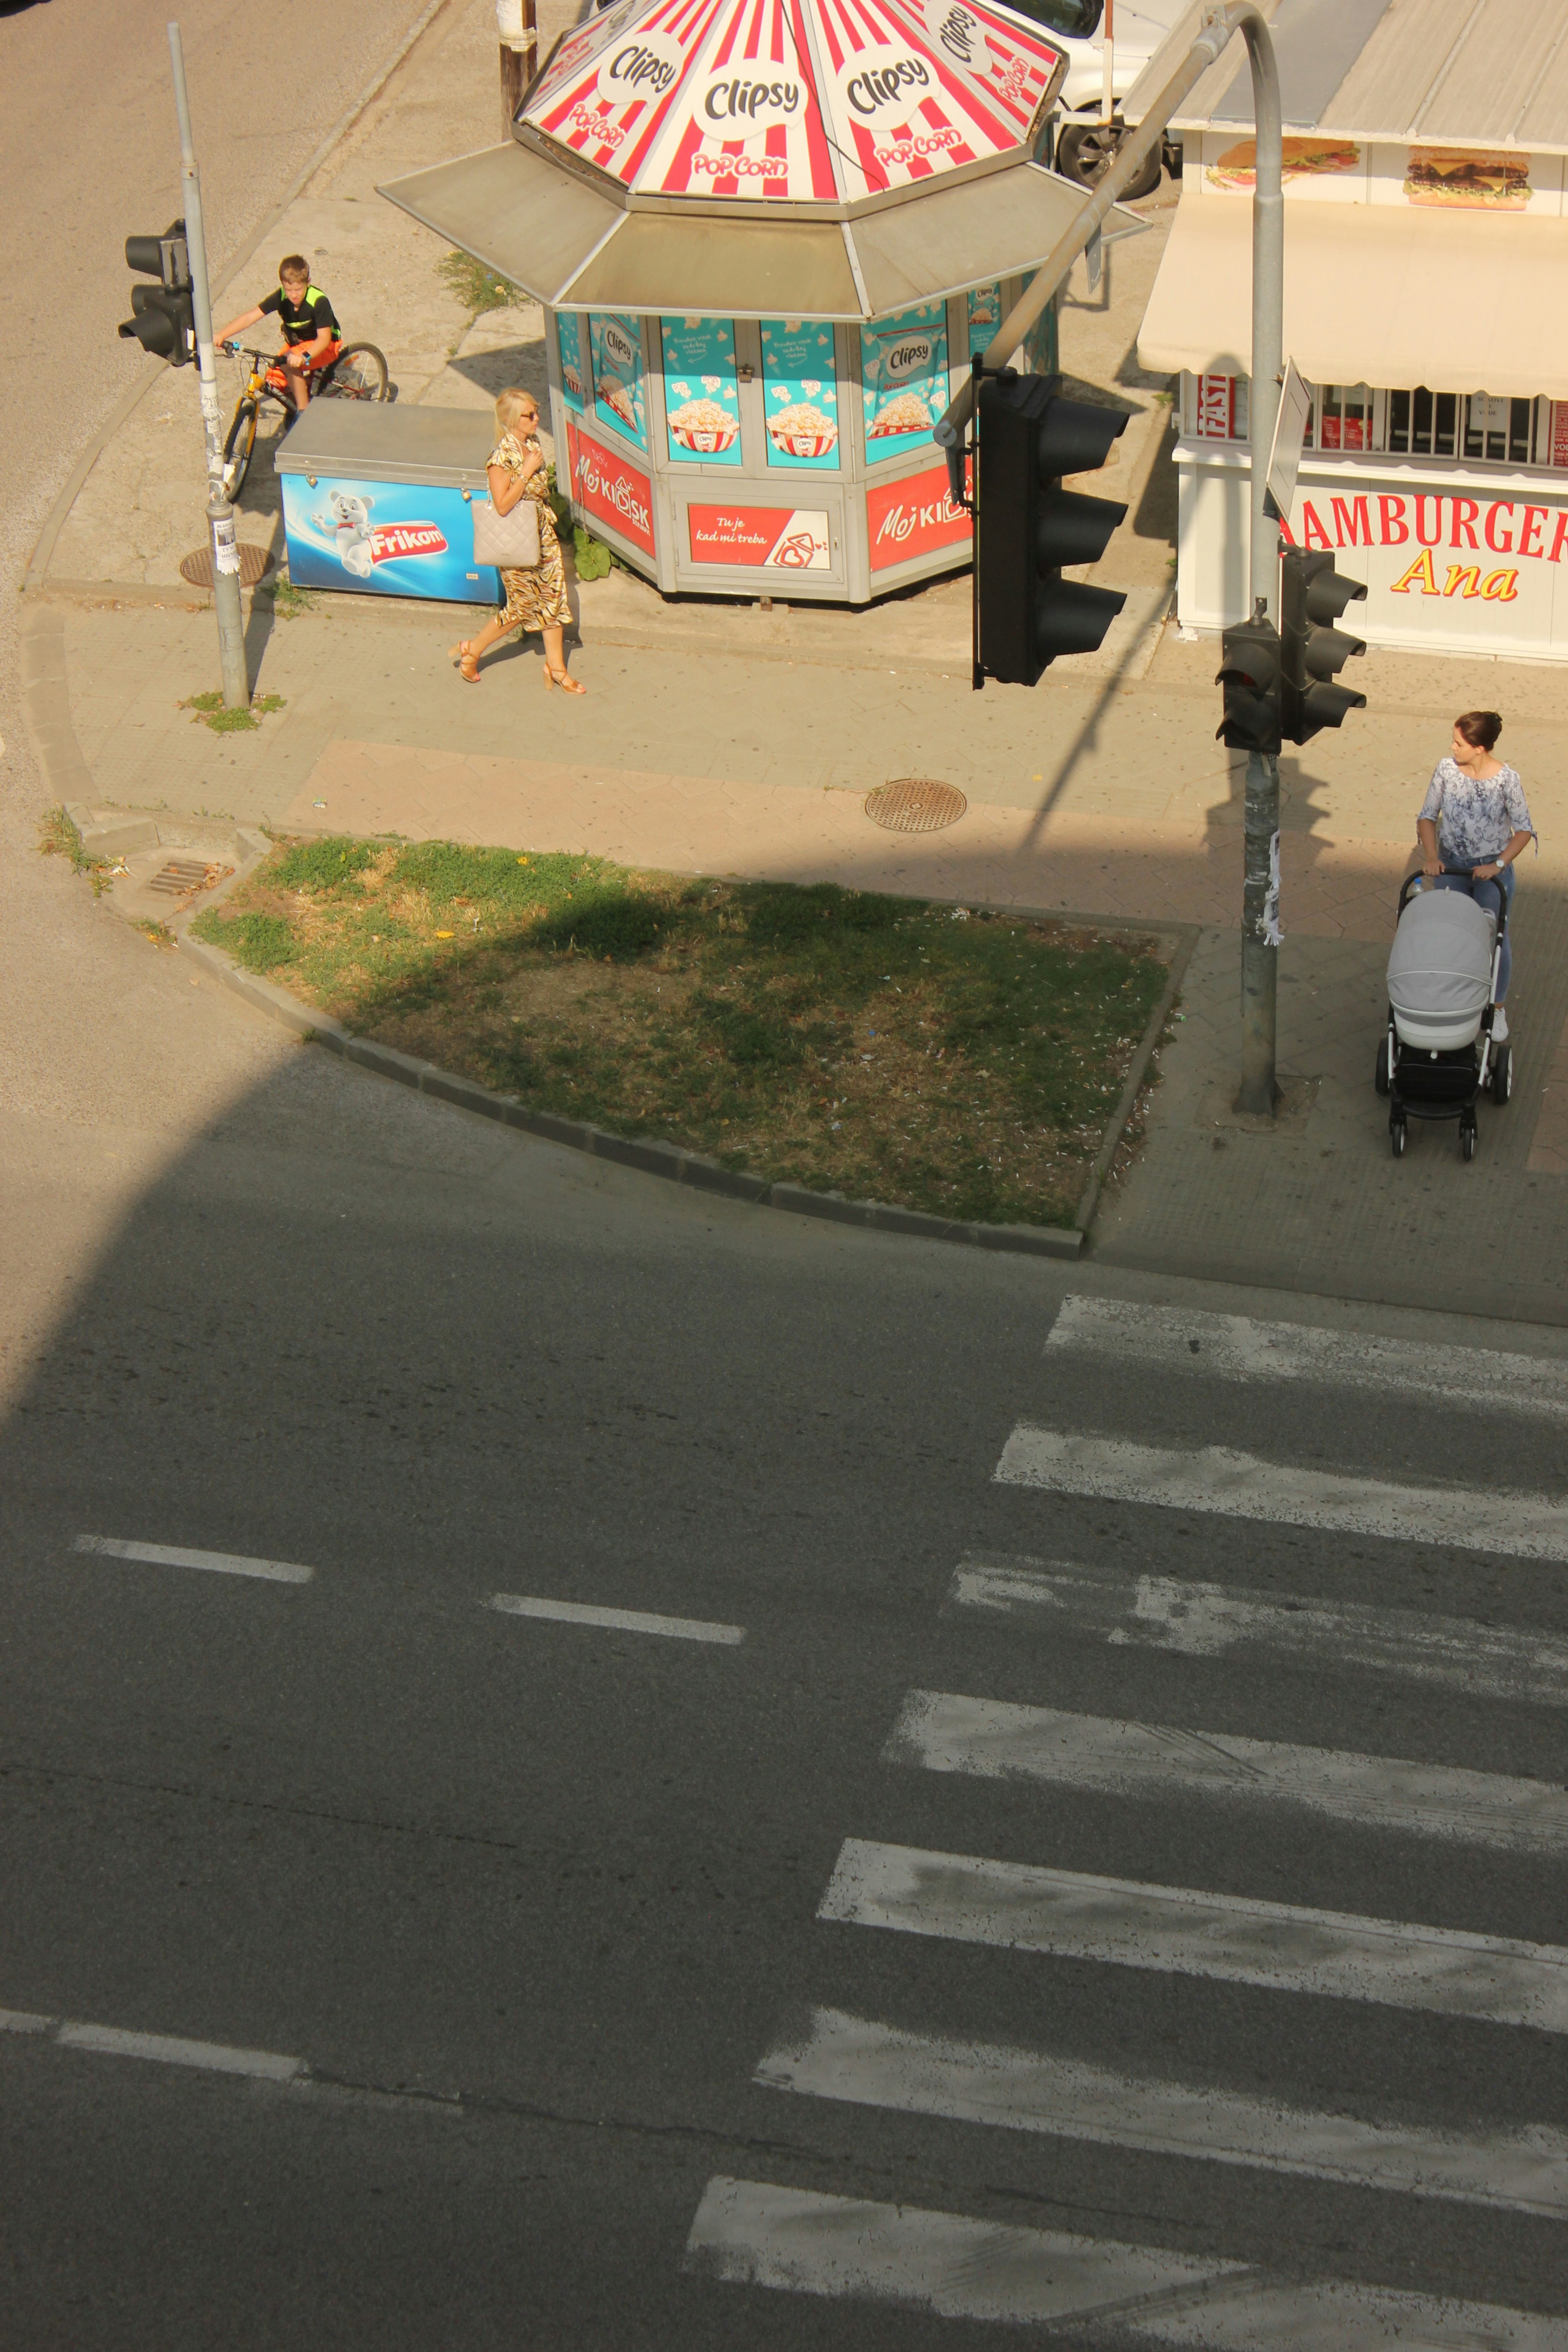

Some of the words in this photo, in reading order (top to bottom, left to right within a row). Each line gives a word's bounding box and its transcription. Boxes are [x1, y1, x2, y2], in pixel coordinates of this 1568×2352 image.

[939, 5, 977, 63] Clipsy
[610, 46, 676, 93] Clipsy
[705, 79, 799, 119] Clipsy
[847, 58, 929, 114] Clipsy
[569, 103, 598, 128] POP
[694, 154, 734, 175] POP
[876, 142, 913, 167] POP
[607, 330, 631, 360] Clipsy
[890, 345, 928, 369] Clipsy
[575, 455, 599, 494] Moj
[601, 476, 650, 529] KIOSK
[696, 530, 718, 541] kad
[720, 533, 737, 542] mi
[737, 533, 767, 544] treba
[717, 518, 733, 527] Tu
[731, 517, 745, 531] je
[876, 505, 917, 544] Moj
[372, 528, 443, 555] Frikom
[1390, 548, 1519, 602] Ana
